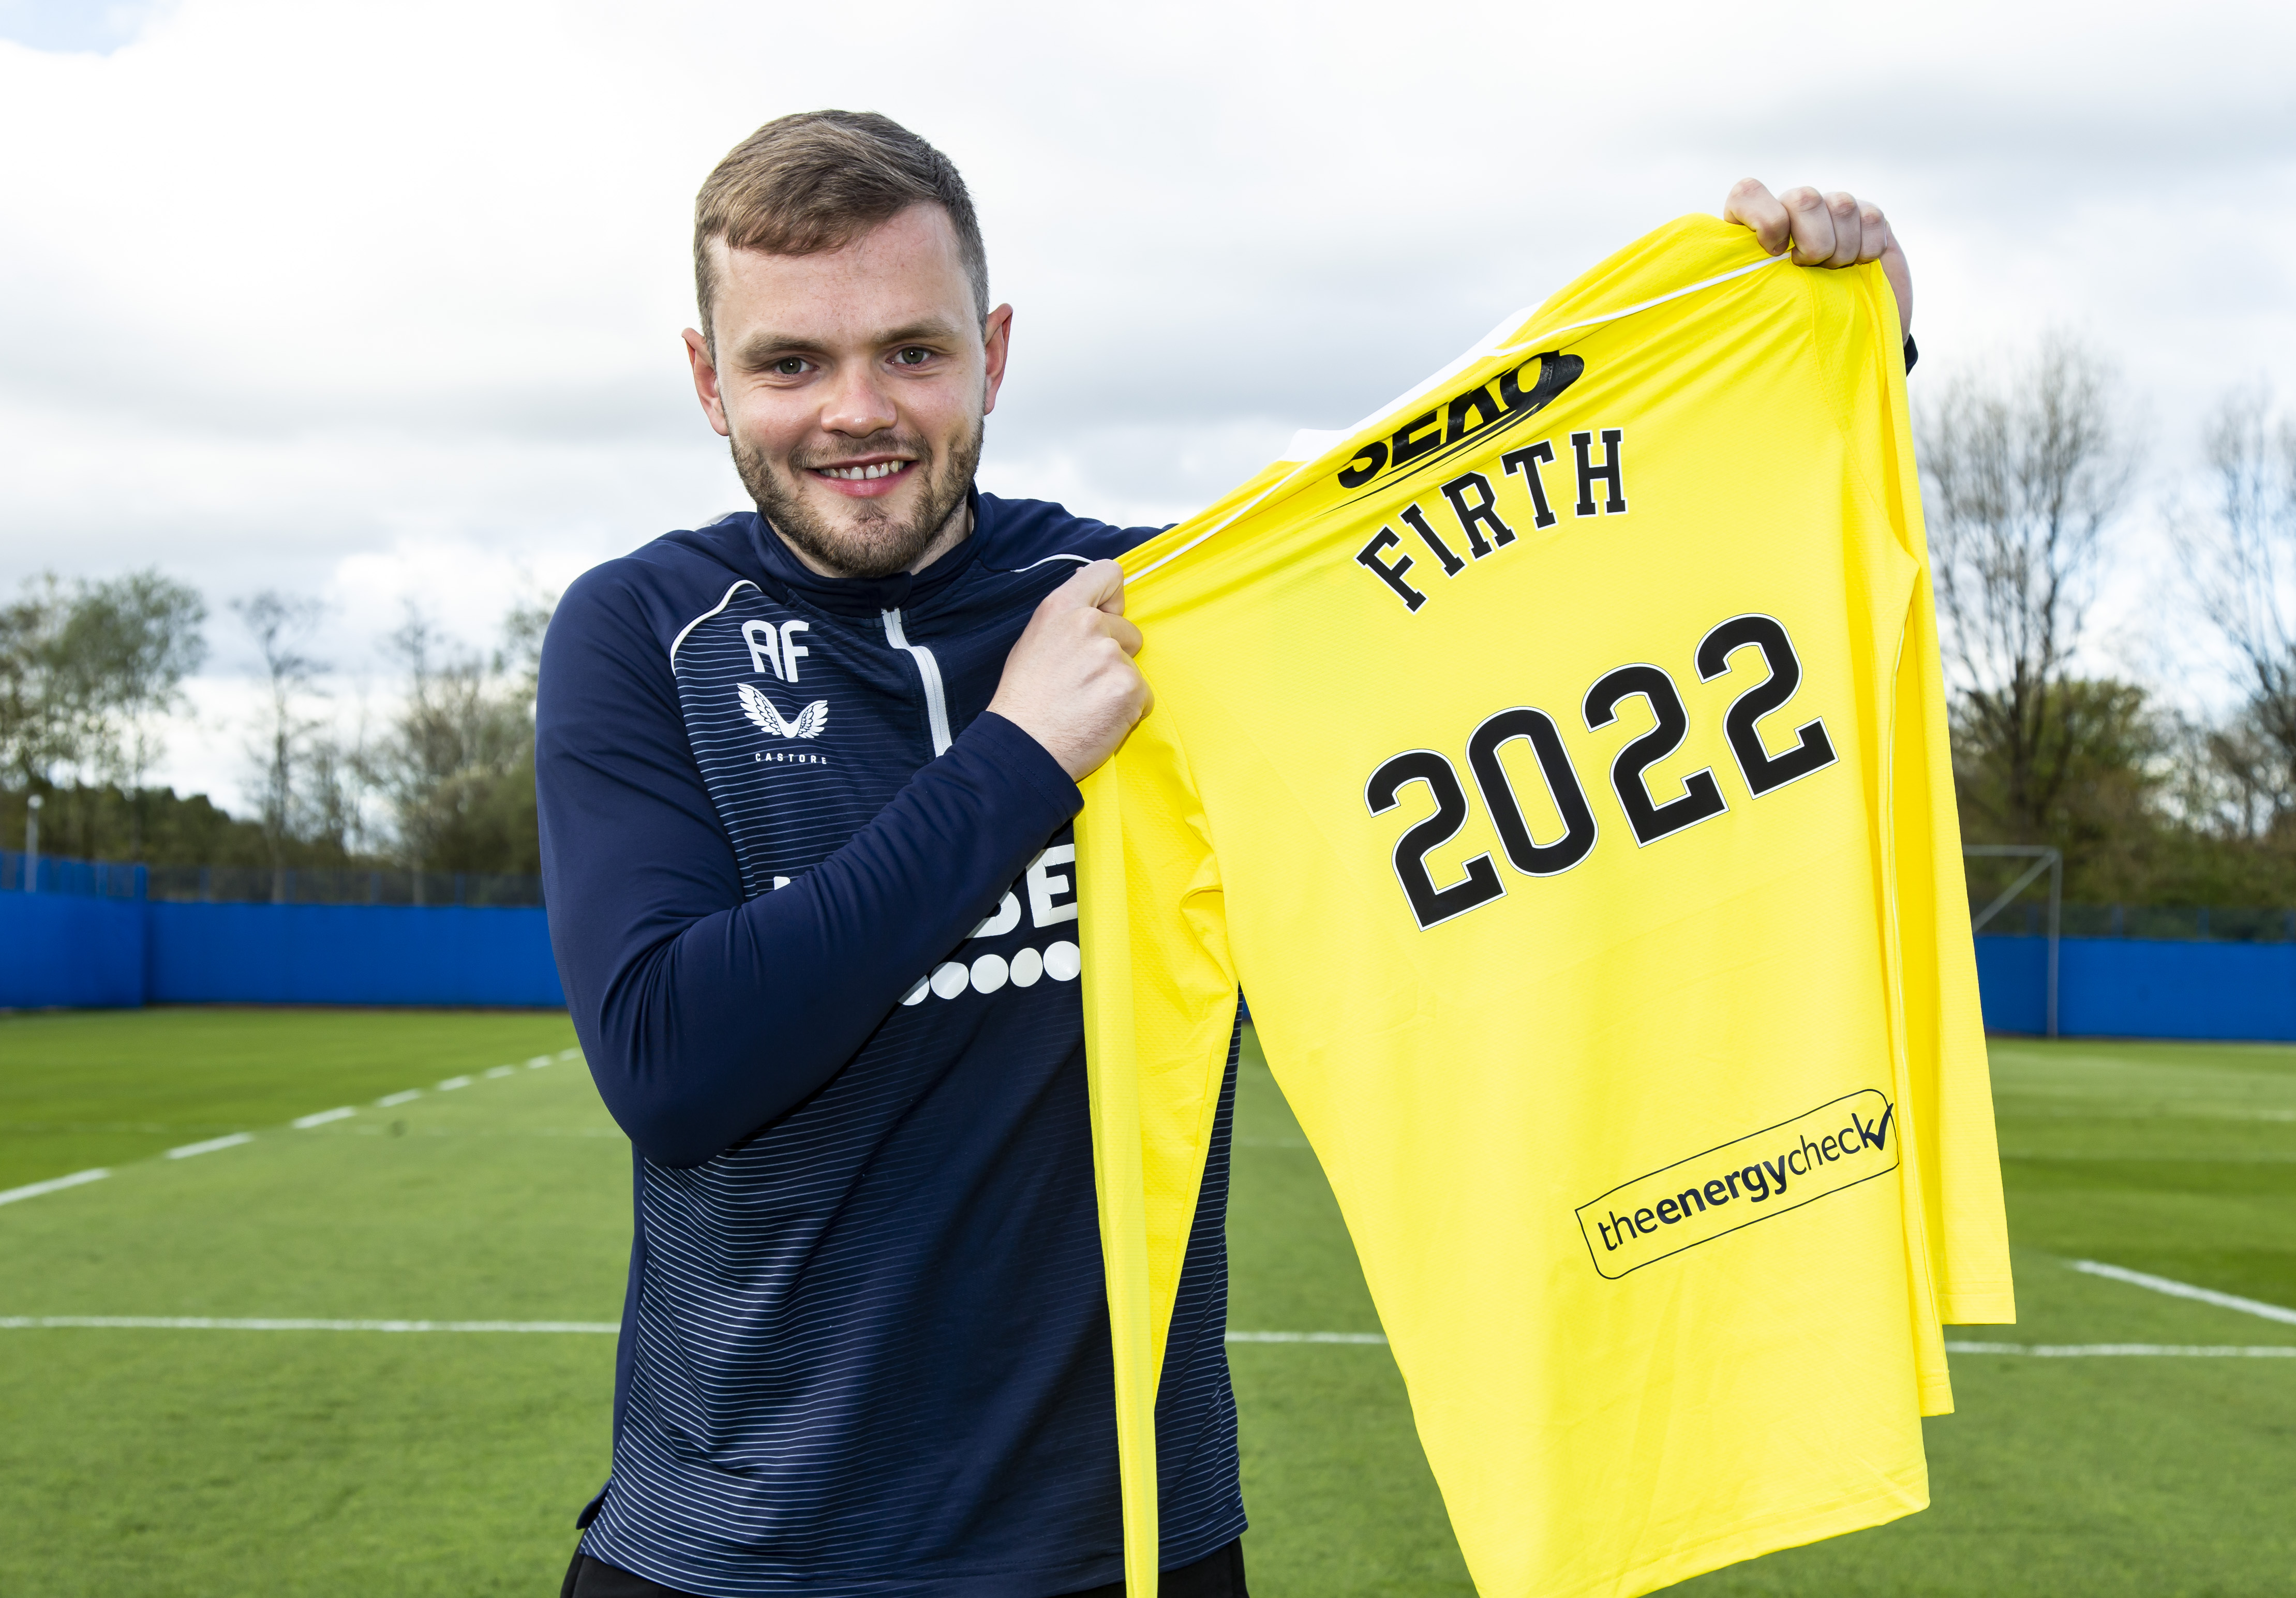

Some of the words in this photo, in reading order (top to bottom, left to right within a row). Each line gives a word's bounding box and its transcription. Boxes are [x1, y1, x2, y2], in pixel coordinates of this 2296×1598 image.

[1353, 427, 1629, 615] FIRTH
[741, 620, 809, 682] AF
[755, 753, 827, 765] CASTORE
[1364, 613, 1840, 932] 2022
[1598, 1112, 1884, 1251] theenergycheck
